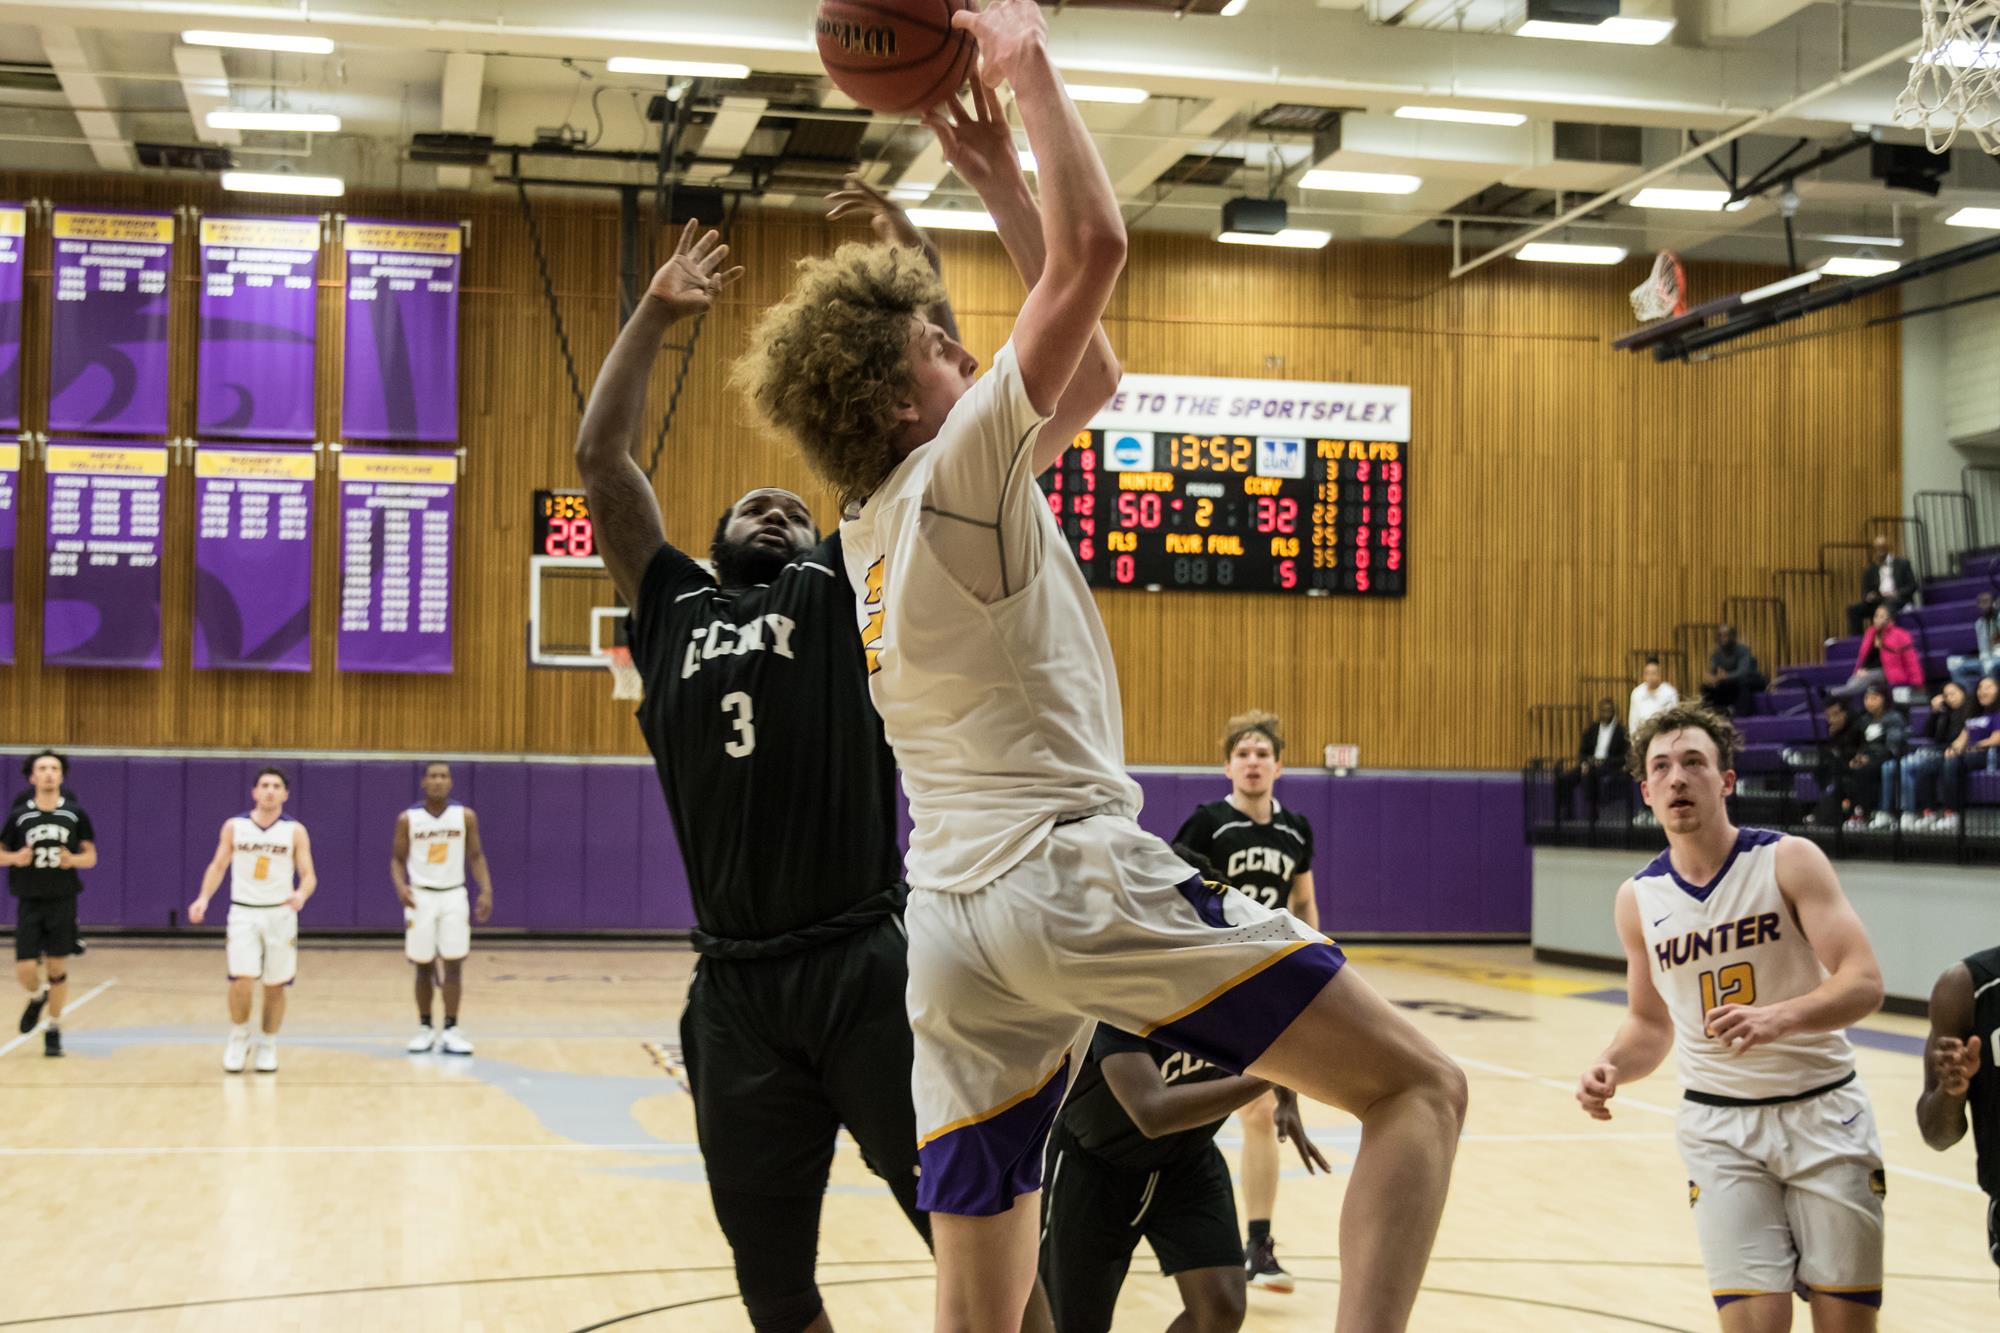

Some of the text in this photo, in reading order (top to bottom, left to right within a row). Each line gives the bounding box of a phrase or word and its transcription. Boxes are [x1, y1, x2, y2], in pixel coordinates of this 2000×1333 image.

[1137, 393, 1166, 413] TO
[1175, 394, 1221, 416] THE
[1229, 397, 1397, 423] SPORTSPLEX
[1170, 435, 1252, 472] 13:52
[1326, 459, 1402, 482] 3 2 13
[1319, 481, 1339, 503] 13
[1387, 483, 1402, 505] 0
[1118, 492, 1162, 528] 50
[1195, 497, 1213, 528] 2
[1257, 497, 1298, 533] 32
[1312, 502, 1338, 525] 22
[1387, 505, 1402, 526] 0
[545, 518, 593, 557] 28
[1355, 525, 1370, 548] 2
[1381, 526, 1402, 548] 12
[1116, 554, 1135, 583] 0
[1279, 559, 1297, 588] 5
[1355, 547, 1370, 569] 0
[680, 612, 796, 678] CCNY
[720, 690, 755, 758] 3
[34, 846, 62, 869] 25
[1227, 846, 1296, 882] CCNY
[1654, 910, 1782, 973] HUNTER
[1698, 960, 1757, 1039] 12
